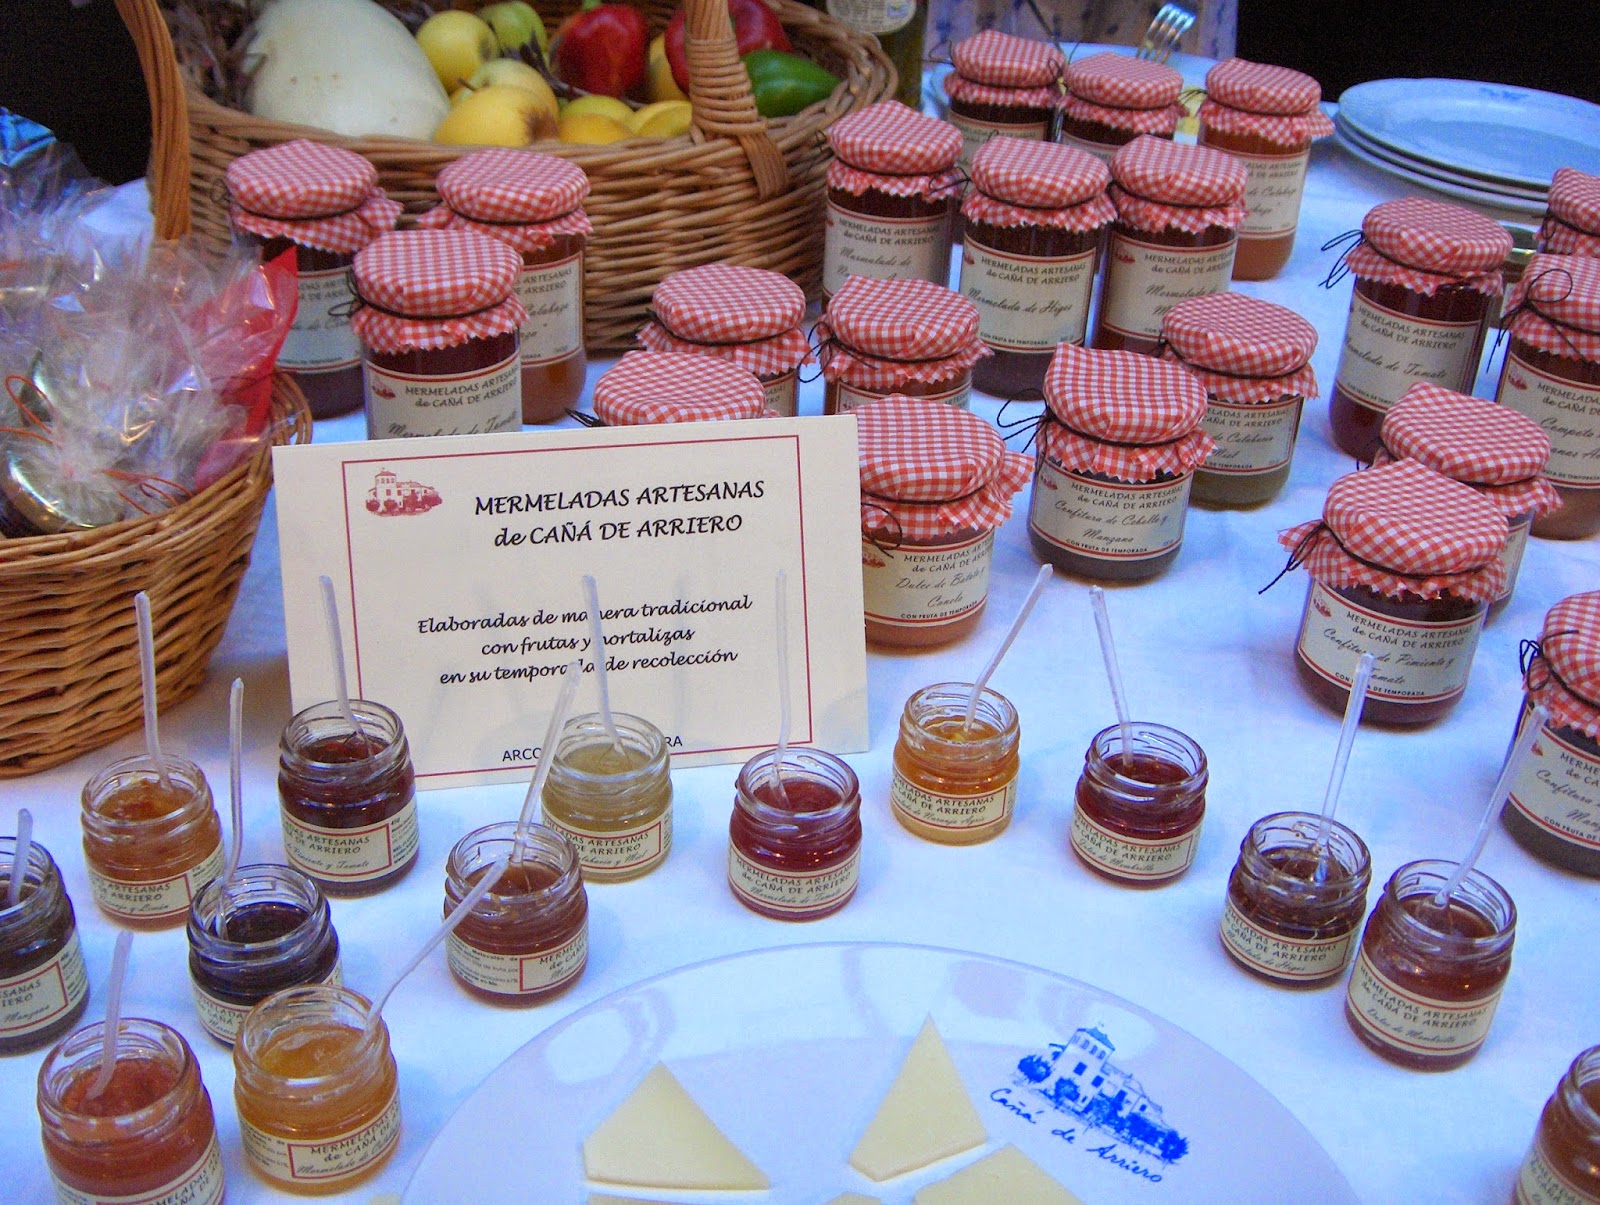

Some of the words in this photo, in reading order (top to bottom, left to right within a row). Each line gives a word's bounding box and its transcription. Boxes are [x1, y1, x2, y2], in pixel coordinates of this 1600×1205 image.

[981, 256, 1038, 274] MERMELADAS
[1026, 276, 1038, 284] DE
[1041, 274, 1079, 284] ARRIERO
[1022, 303, 1037, 312] de
[1413, 328, 1465, 339] ARTESANAS
[1397, 334, 1408, 343] DE
[1412, 340, 1456, 349] ARRIERO
[406, 383, 479, 396] MERMELADAS
[415, 398, 430, 406] de
[468, 395, 480, 405] DE
[1244, 419, 1282, 427] ARRIERO
[475, 489, 629, 515] MERMELADAS
[637, 480, 765, 505] ARTESANAS
[1071, 482, 1136, 499] MERMELADAS
[1139, 485, 1182, 500] ARTESANAS
[1139, 496, 1176, 509] ARRIERO
[1106, 515, 1119, 525] de
[495, 528, 526, 547] de
[530, 520, 592, 544] CAÑÁ
[600, 522, 630, 540] DE
[637, 515, 742, 537] ARRIERO
[1067, 539, 1080, 547] CON
[1082, 543, 1099, 551] FRUTA
[904, 550, 969, 562] MERMELADAS
[895, 578, 931, 589] Dulce
[932, 578, 946, 588] de
[418, 613, 529, 633] Elaboradas
[533, 610, 557, 624] de
[642, 595, 752, 617] tradicional
[949, 601, 977, 615] TEMPORADA
[1347, 611, 1418, 638] MERMELADAS
[1421, 627, 1473, 638] ARTESANAS
[1352, 626, 1366, 635] de
[1402, 639, 1416, 648] DE
[1420, 638, 1464, 648] ARRIERO
[482, 641, 517, 656] con
[520, 636, 579, 655] frutas
[581, 637, 591, 652] y
[1377, 653, 1390, 663] de
[440, 671, 466, 684] en
[469, 670, 491, 682] su
[606, 657, 629, 671] de
[632, 650, 738, 669] recolección
[1336, 672, 1349, 681] CON
[1566, 768, 1580, 779] de
[921, 800, 932, 810] DE
[937, 805, 986, 815] ARRIERO
[936, 797, 994, 806] ARTESANAS
[1545, 816, 1560, 827] CON
[1563, 826, 1584, 837] FRUTA
[307, 834, 369, 846] ARTESANAS
[588, 833, 648, 846] ARTESANAS
[309, 844, 361, 854] ARRIERO
[590, 844, 640, 855] ARRIERO
[1106, 846, 1117, 855] DE
[1122, 853, 1171, 862] ARRIERO
[1122, 844, 1181, 853] ARTESANAS
[737, 859, 801, 885] MERMELADAS
[108, 883, 170, 893] ARTESANAS
[788, 886, 801, 894] DE
[807, 872, 851, 893] ARRIERO
[1256, 942, 1268, 952] DE
[1273, 951, 1326, 962] ARRIERO
[1273, 942, 1336, 953] ARTESANAS
[1403, 1013, 1418, 1022] DE
[1423, 1019, 1476, 1028] ARRIERO
[325, 1153, 340, 1162] de
[1052, 1129, 1075, 1144] de
[1086, 1144, 1162, 1182] Arriero
